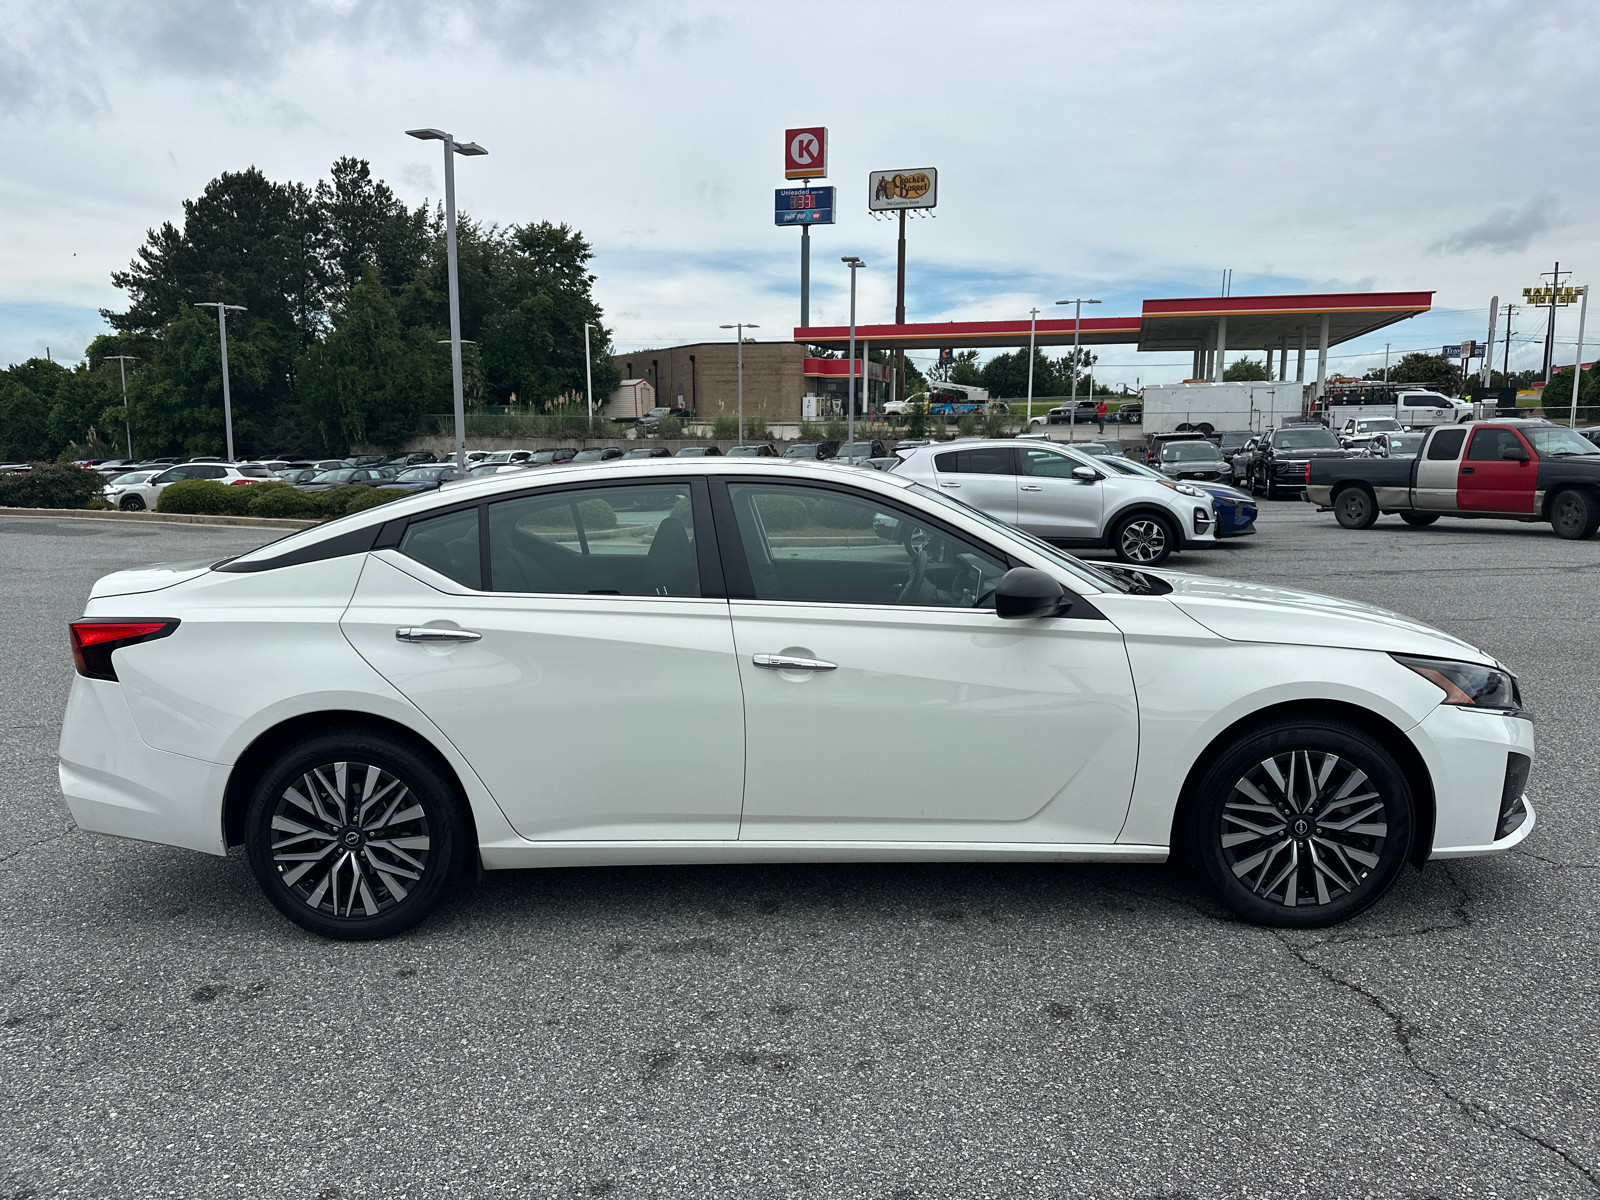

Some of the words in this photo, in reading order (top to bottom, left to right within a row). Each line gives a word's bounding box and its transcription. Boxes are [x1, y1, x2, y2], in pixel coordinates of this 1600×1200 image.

[797, 138, 817, 162] K
[893, 175, 926, 188] Cracker
[900, 183, 927, 198] Barrel
